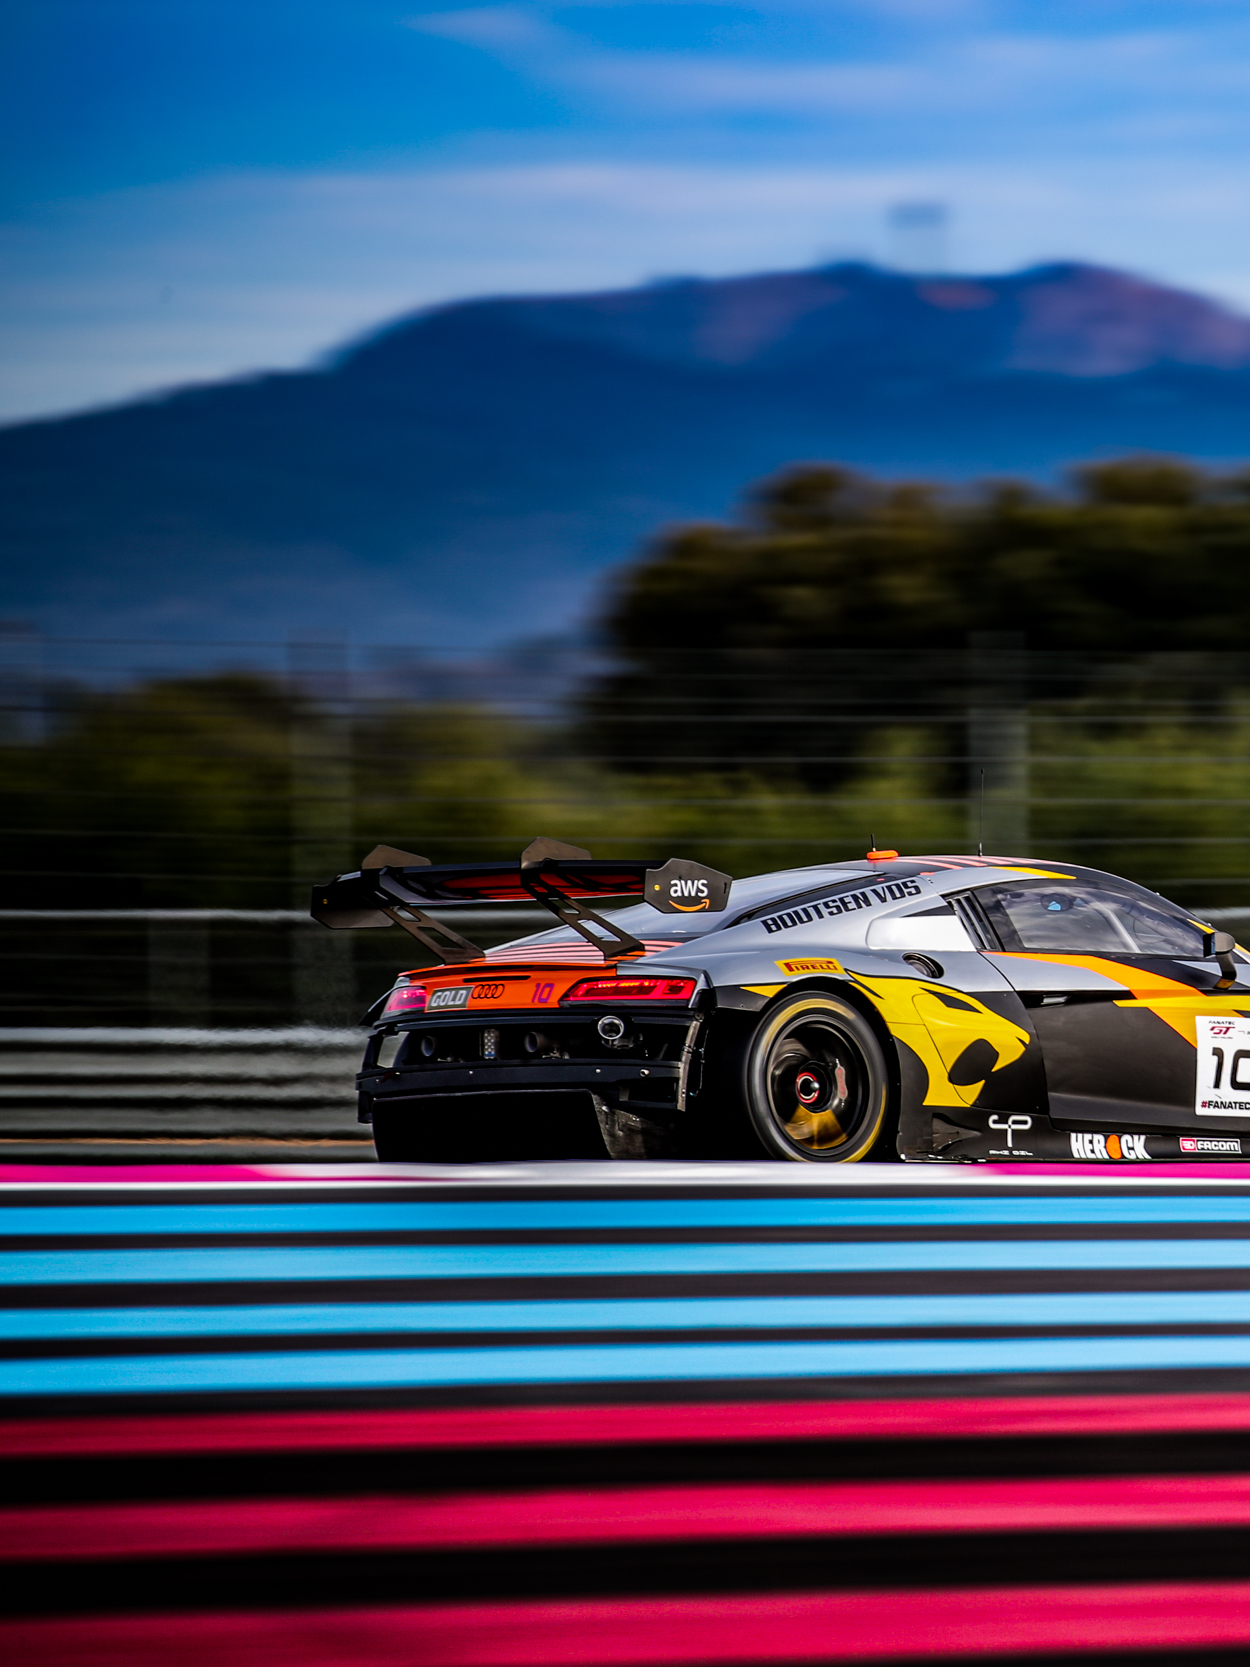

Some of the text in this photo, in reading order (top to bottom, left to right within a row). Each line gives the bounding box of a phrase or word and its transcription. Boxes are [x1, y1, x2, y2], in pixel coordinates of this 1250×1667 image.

[669, 879, 709, 897] aws
[760, 879, 922, 934] BOUTSEN VDS
[783, 960, 839, 973] PIRELLI
[430, 989, 468, 1007] GOLD
[531, 982, 555, 1003] 10
[1209, 1026, 1236, 1035] GT
[1197, 1141, 1239, 1151] FACOM
